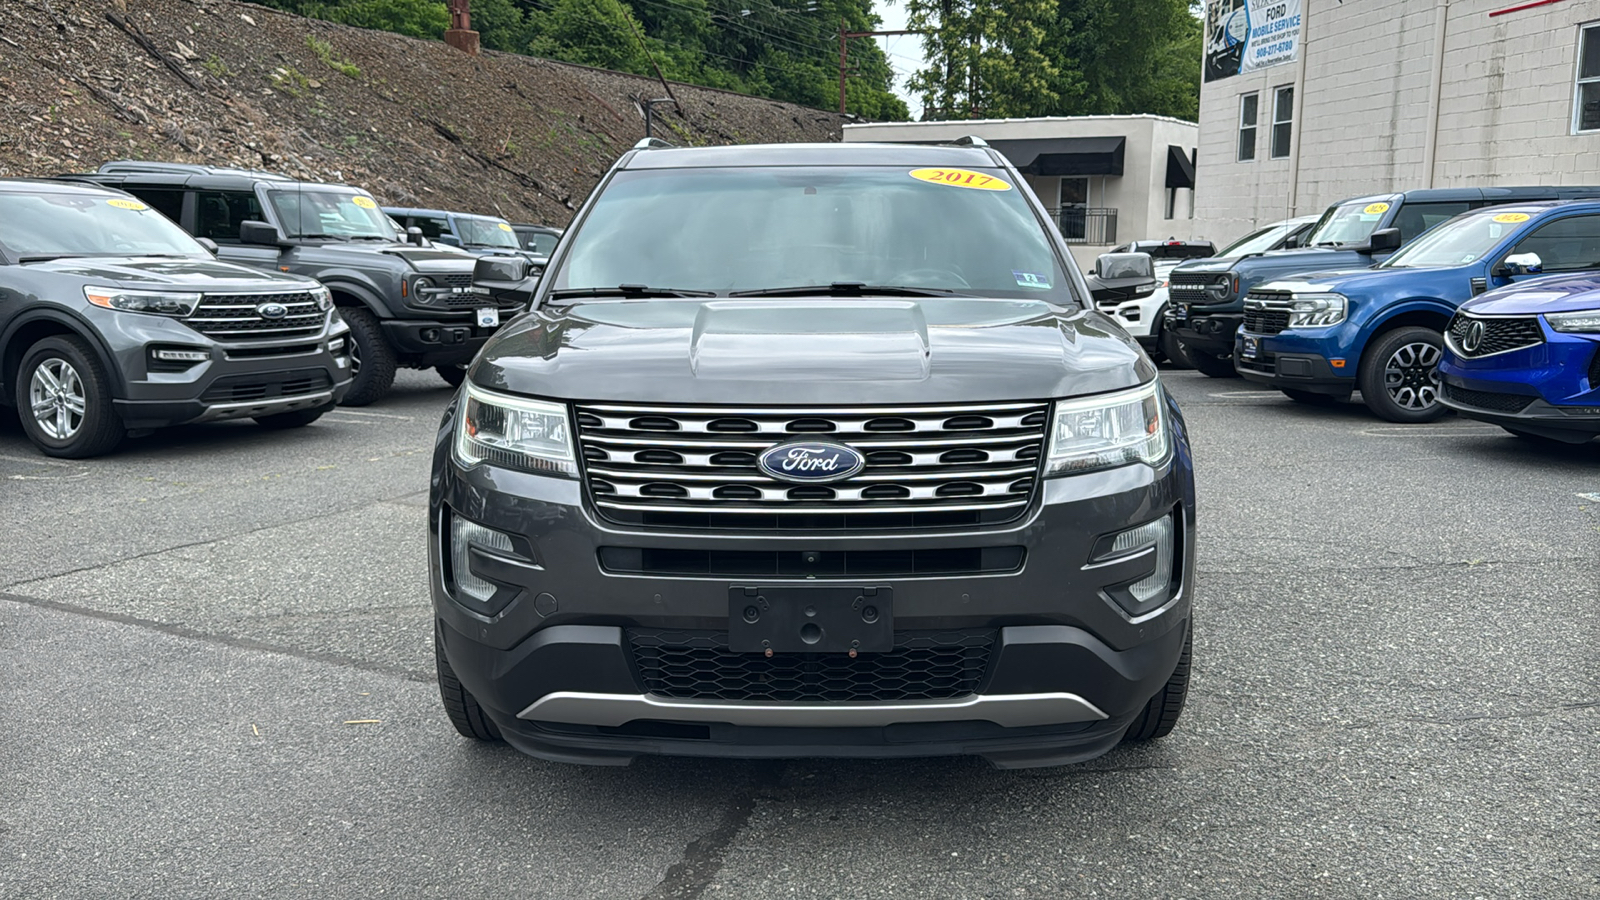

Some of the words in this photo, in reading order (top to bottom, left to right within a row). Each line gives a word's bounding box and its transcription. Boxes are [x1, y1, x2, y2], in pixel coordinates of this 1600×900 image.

[1265, 3, 1286, 22] FORD
[1252, 22, 1273, 39] MOBILE
[1274, 14, 1301, 32] SERVICE
[1256, 40, 1293, 58] 908-277-6780
[928, 171, 994, 186] 2017
[782, 447, 840, 471] Ford
